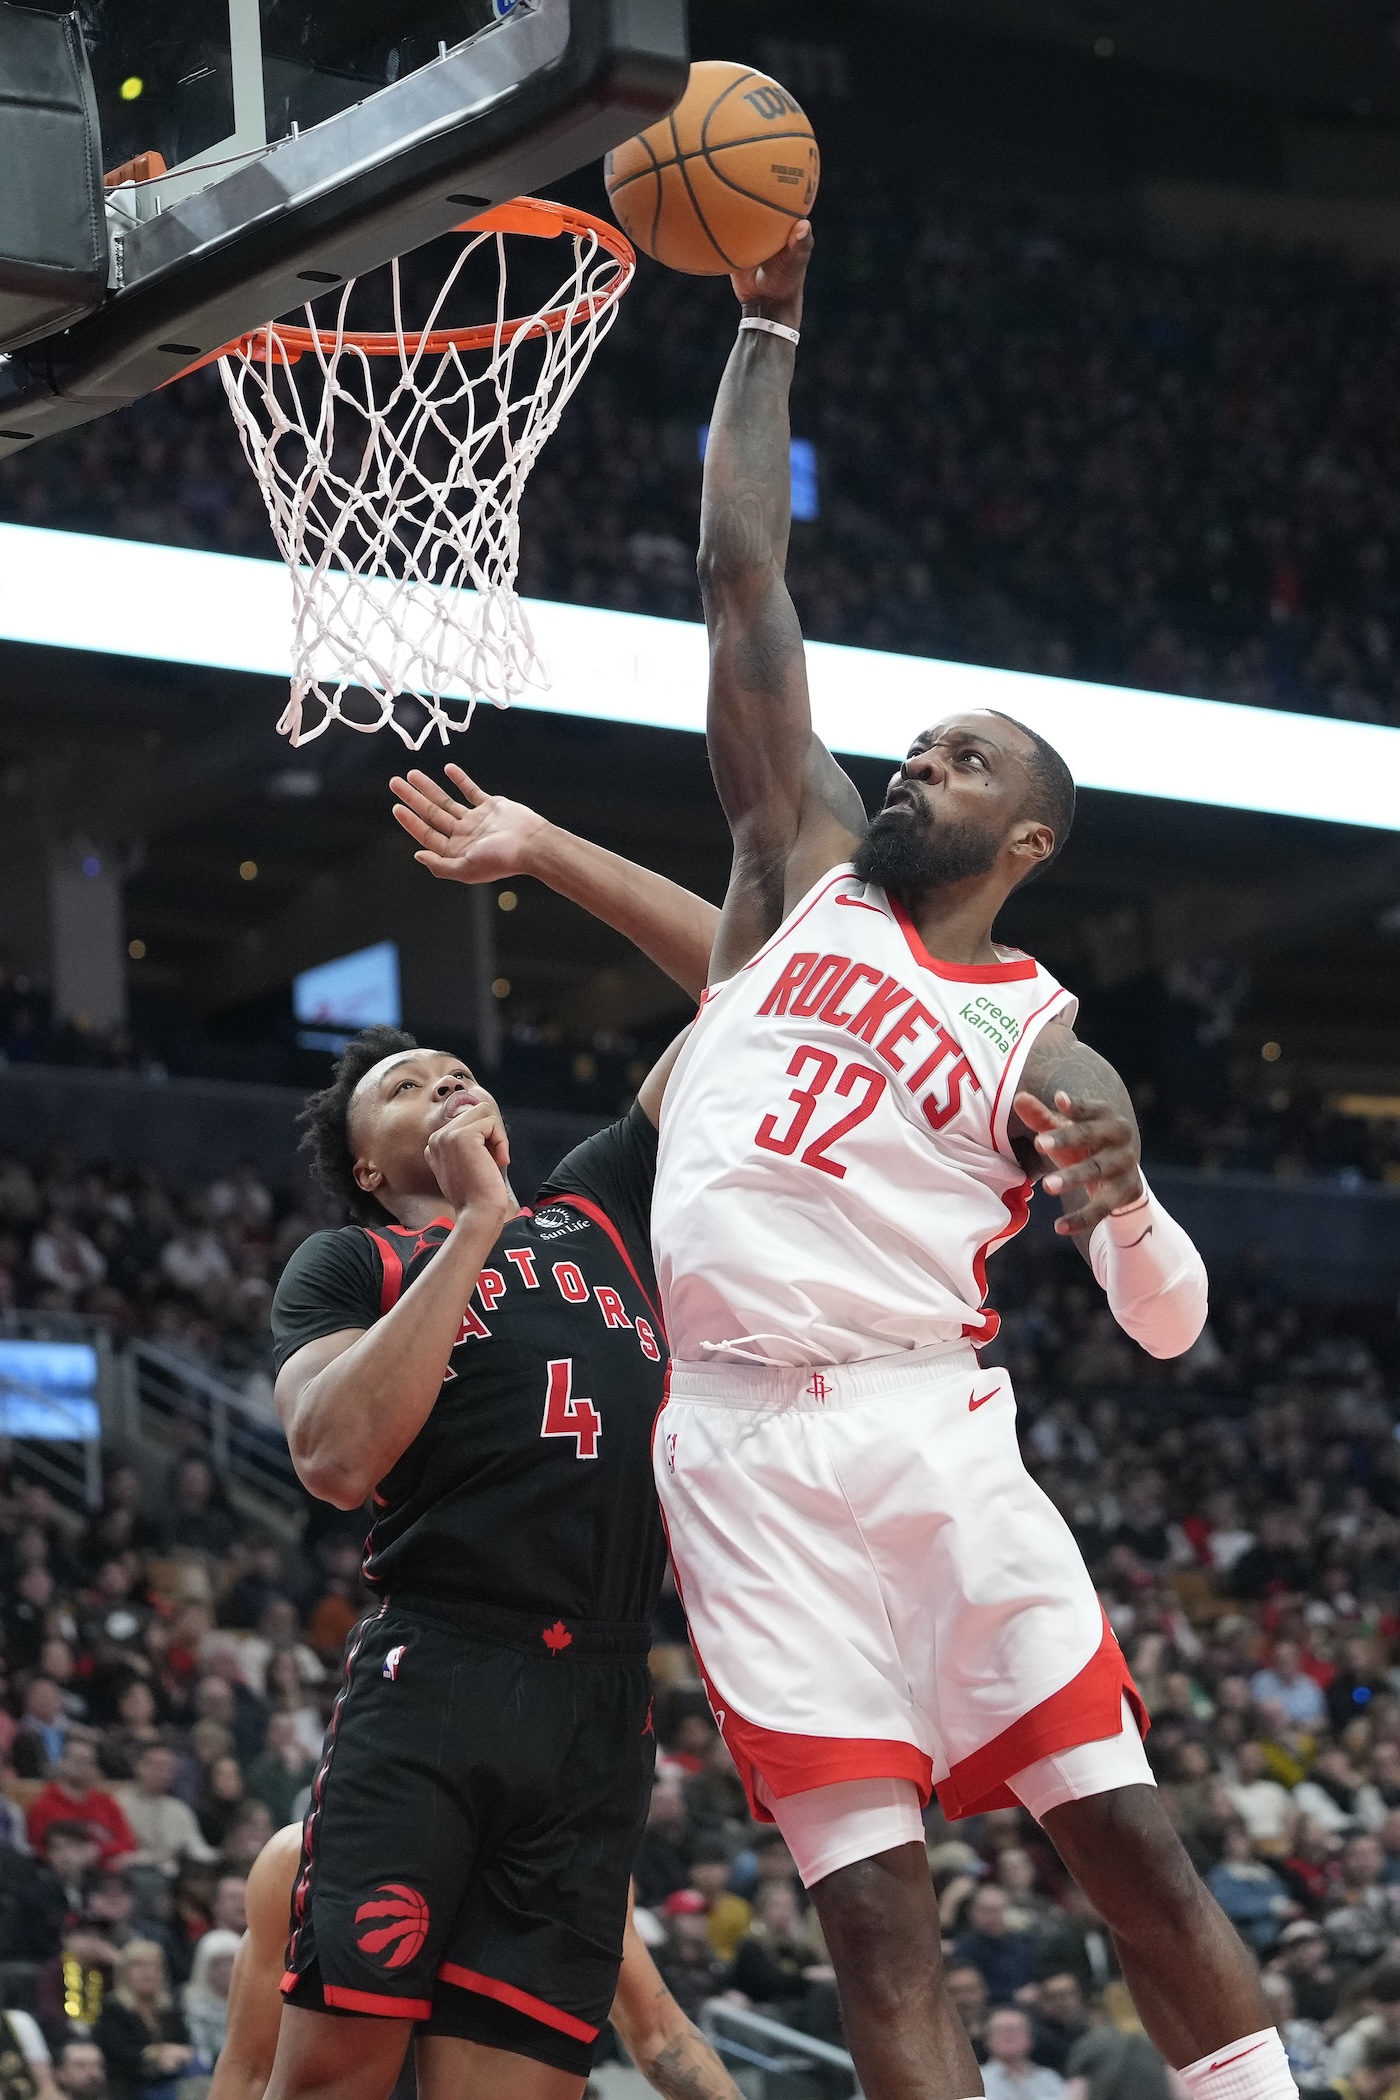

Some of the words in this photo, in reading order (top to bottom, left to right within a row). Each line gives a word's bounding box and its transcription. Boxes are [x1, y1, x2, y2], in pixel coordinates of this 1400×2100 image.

[754, 952, 982, 1131] ROCKETS
[958, 1003, 1009, 1054] karma
[975, 997, 1020, 1042] credit
[754, 1044, 887, 1180] 32
[540, 1228, 567, 1241] Sun
[565, 1220, 591, 1233] Life
[444, 1247, 661, 1382] APTORS
[540, 1358, 602, 1460] 4
